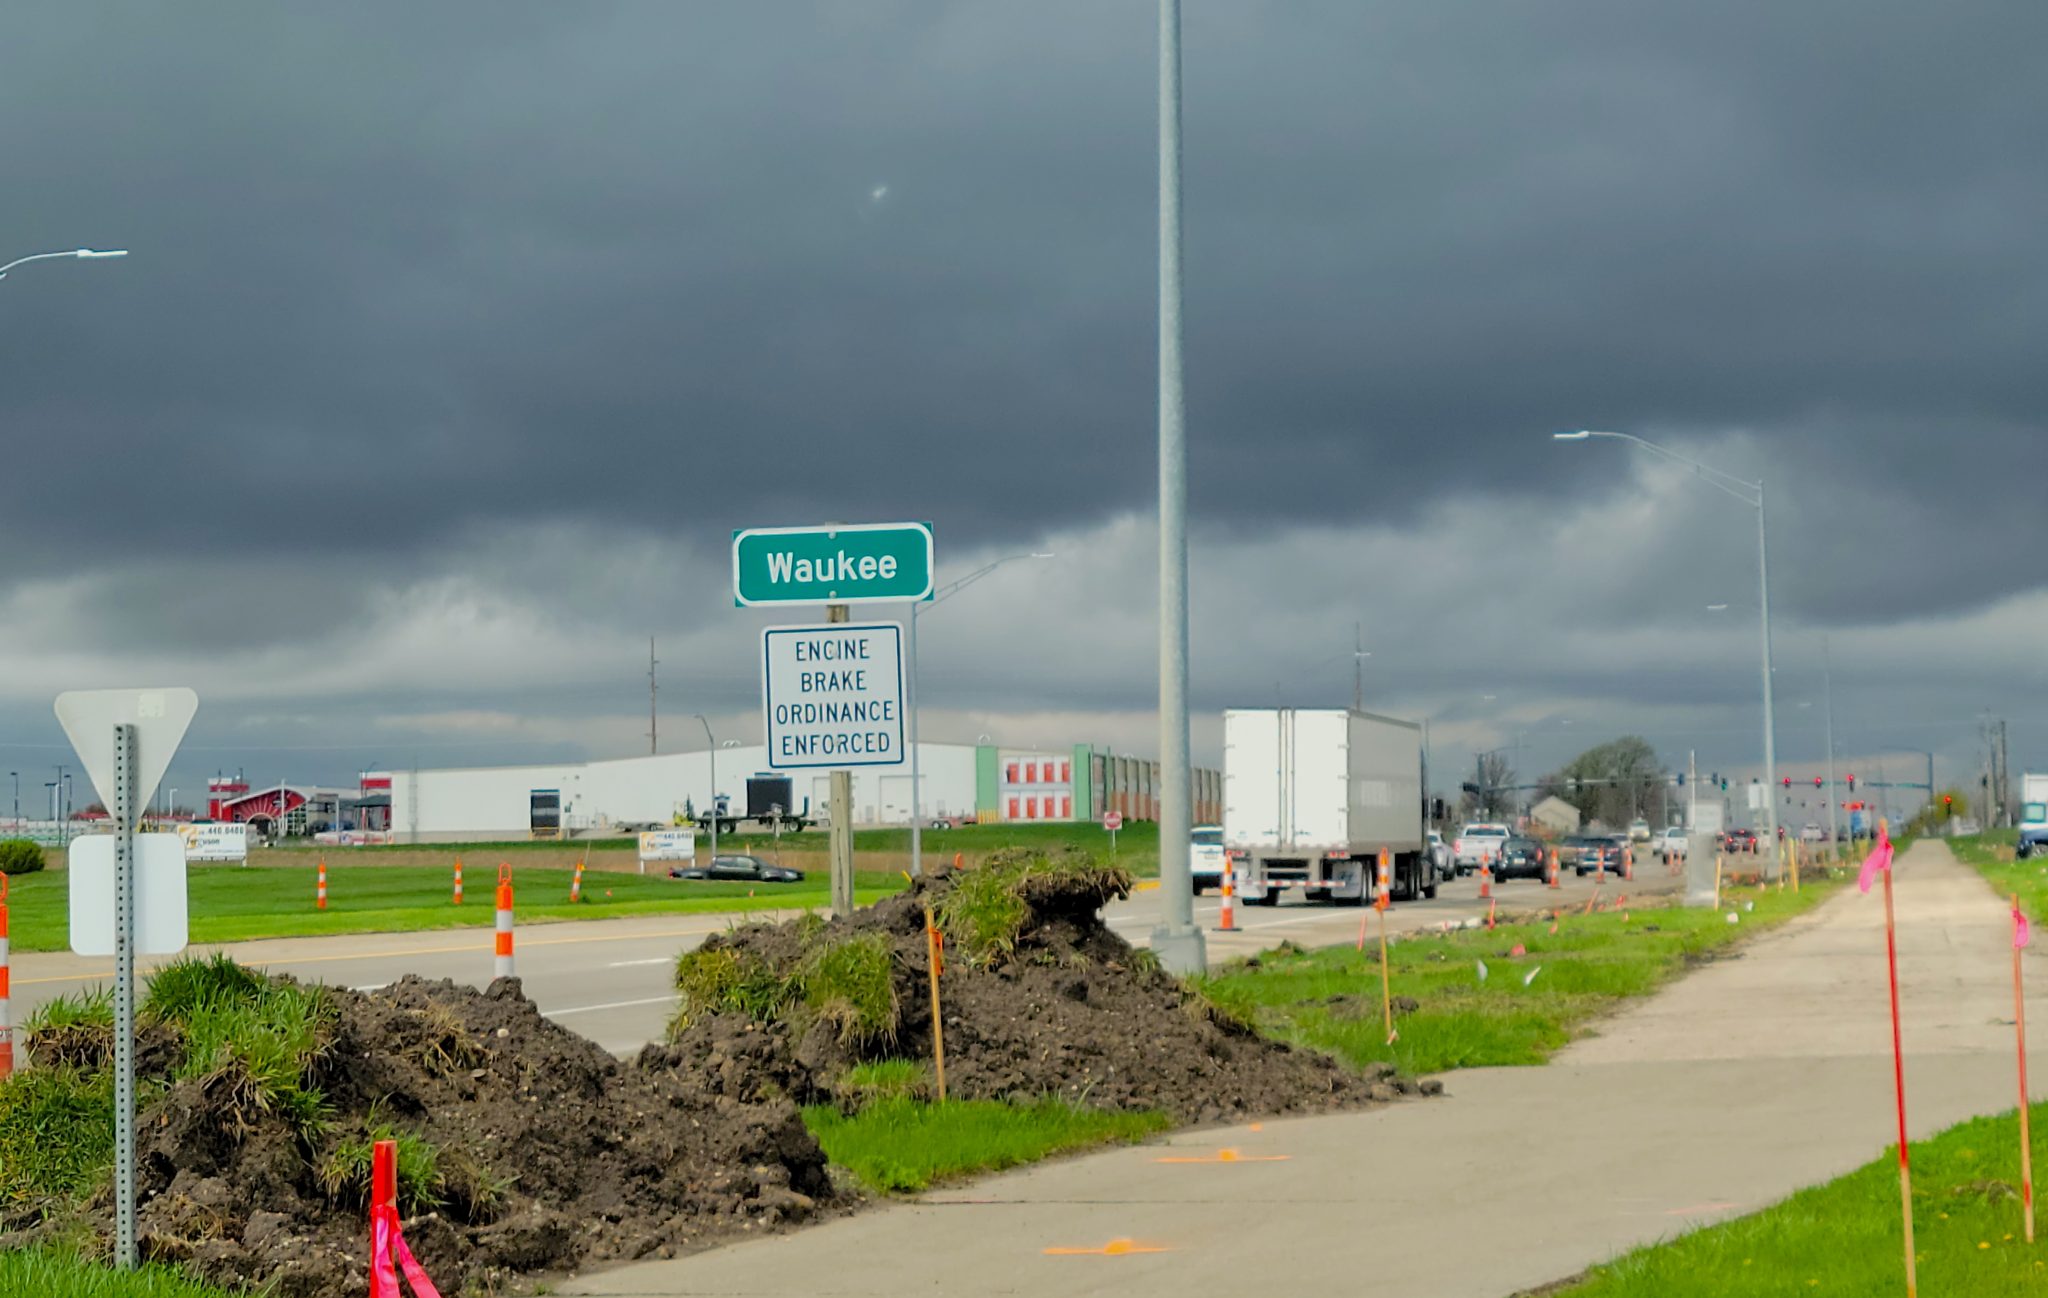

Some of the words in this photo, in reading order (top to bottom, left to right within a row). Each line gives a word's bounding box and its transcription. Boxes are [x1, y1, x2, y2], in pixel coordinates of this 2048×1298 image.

[767, 549, 898, 584] Waukee
[795, 638, 871, 662] ENGINE
[801, 669, 868, 693] BRAKE
[776, 700, 895, 725] ORDINANCE
[782, 731, 891, 756] ENFORCED
